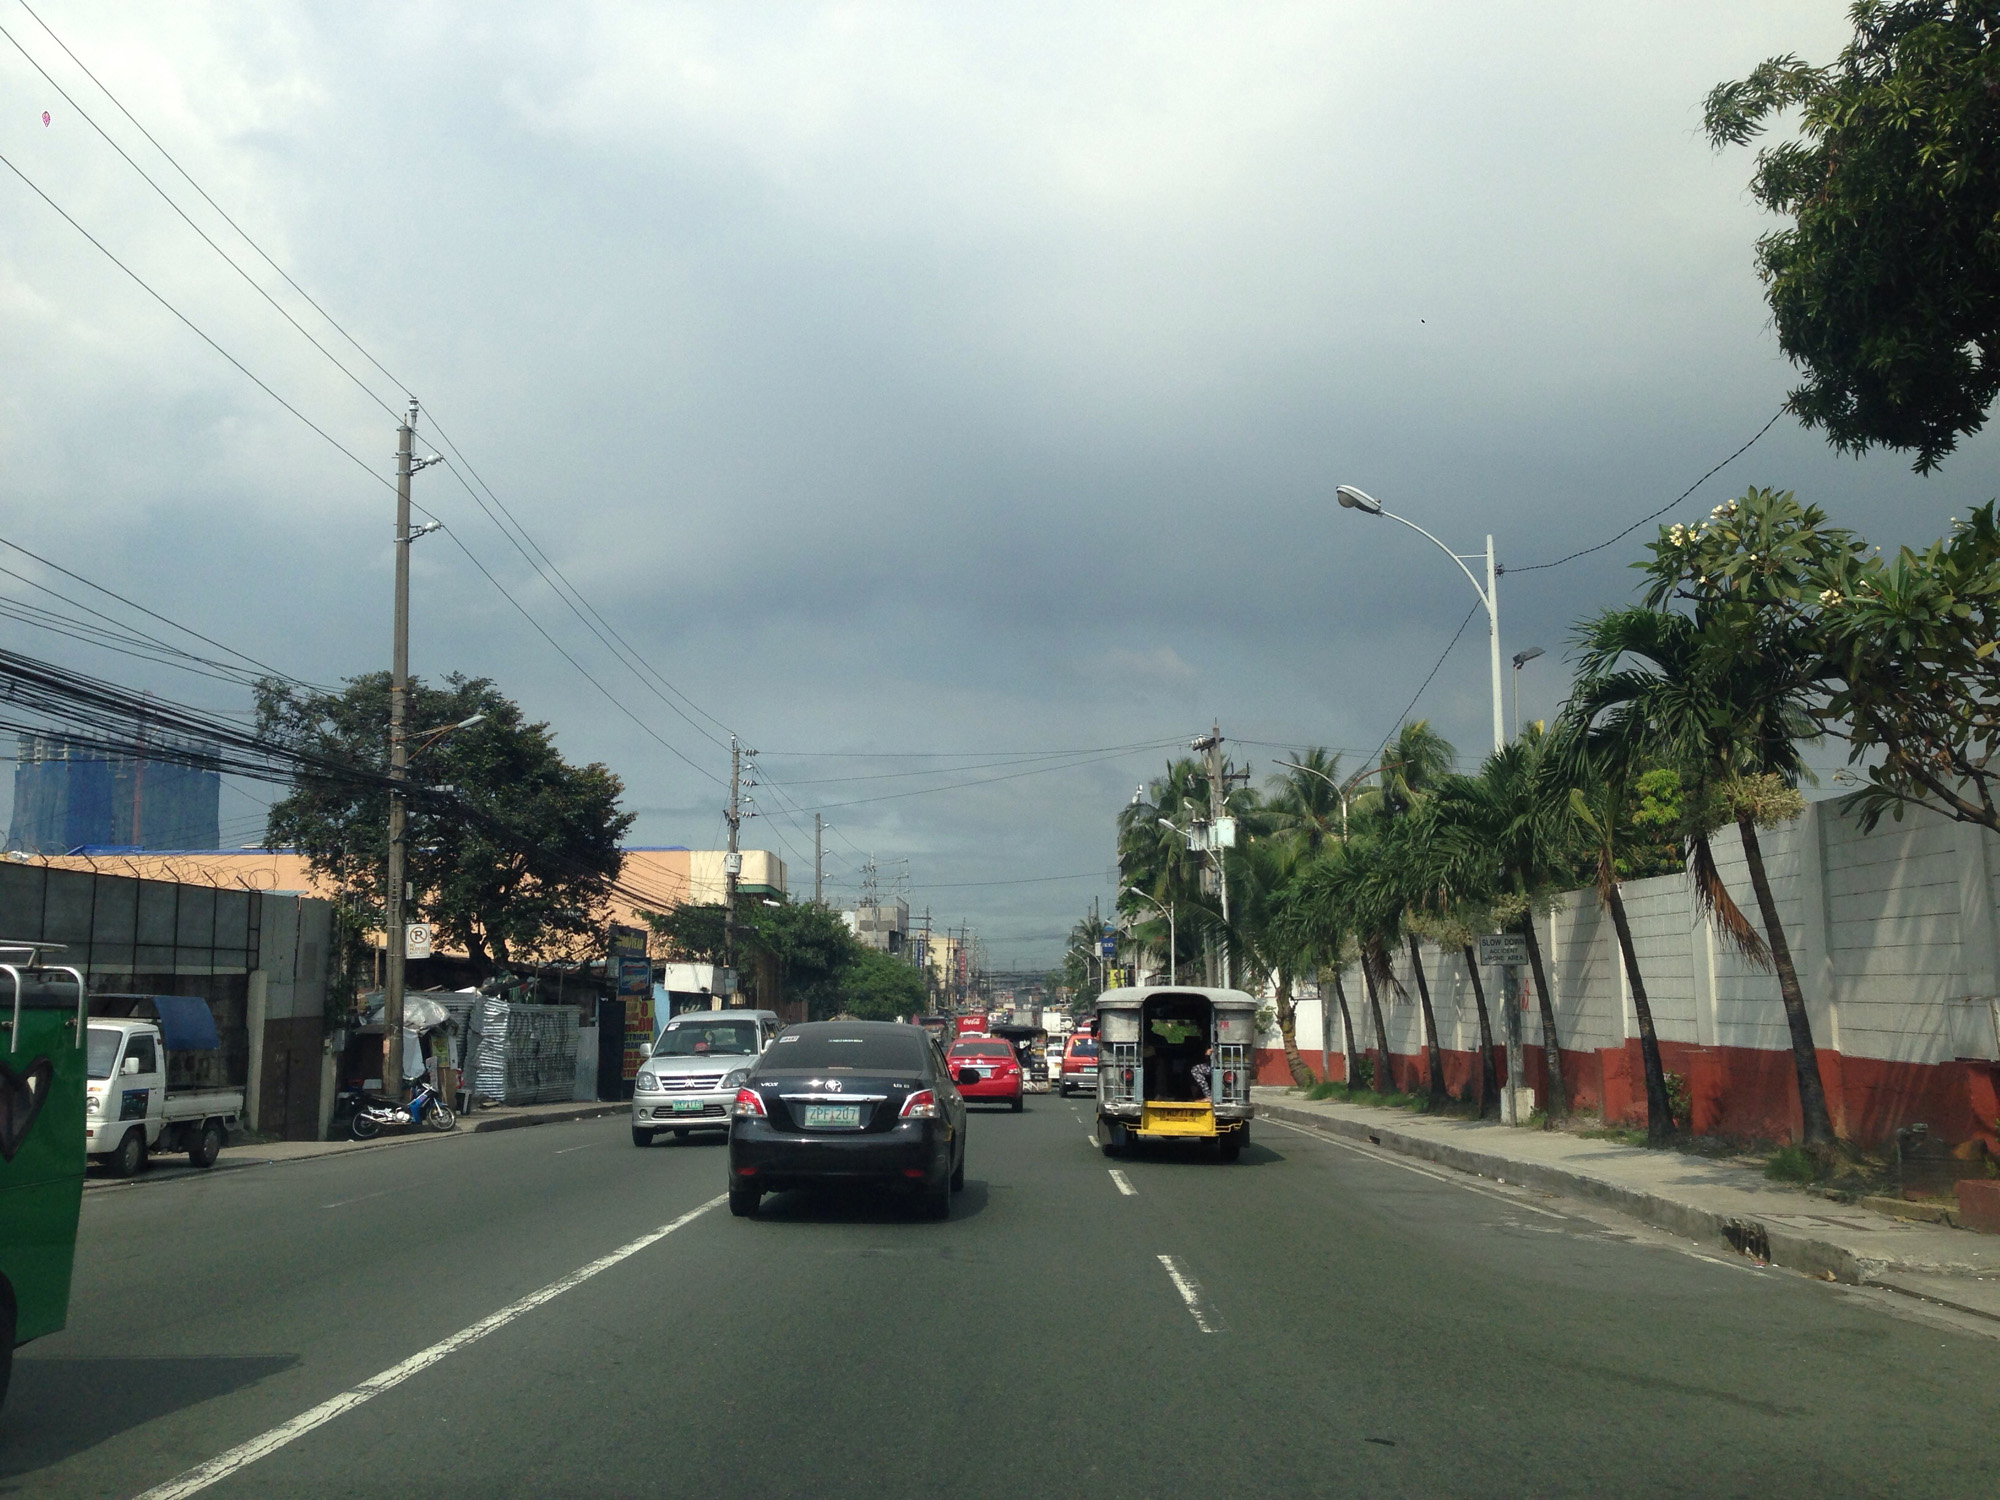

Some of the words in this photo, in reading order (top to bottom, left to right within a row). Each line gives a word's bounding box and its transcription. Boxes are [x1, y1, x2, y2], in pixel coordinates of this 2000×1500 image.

[1481, 938, 1501, 946] SLOW
[1504, 938, 1525, 946] DOWN
[810, 1109, 831, 1120] ZPF
[835, 1109, 857, 1120] 207
